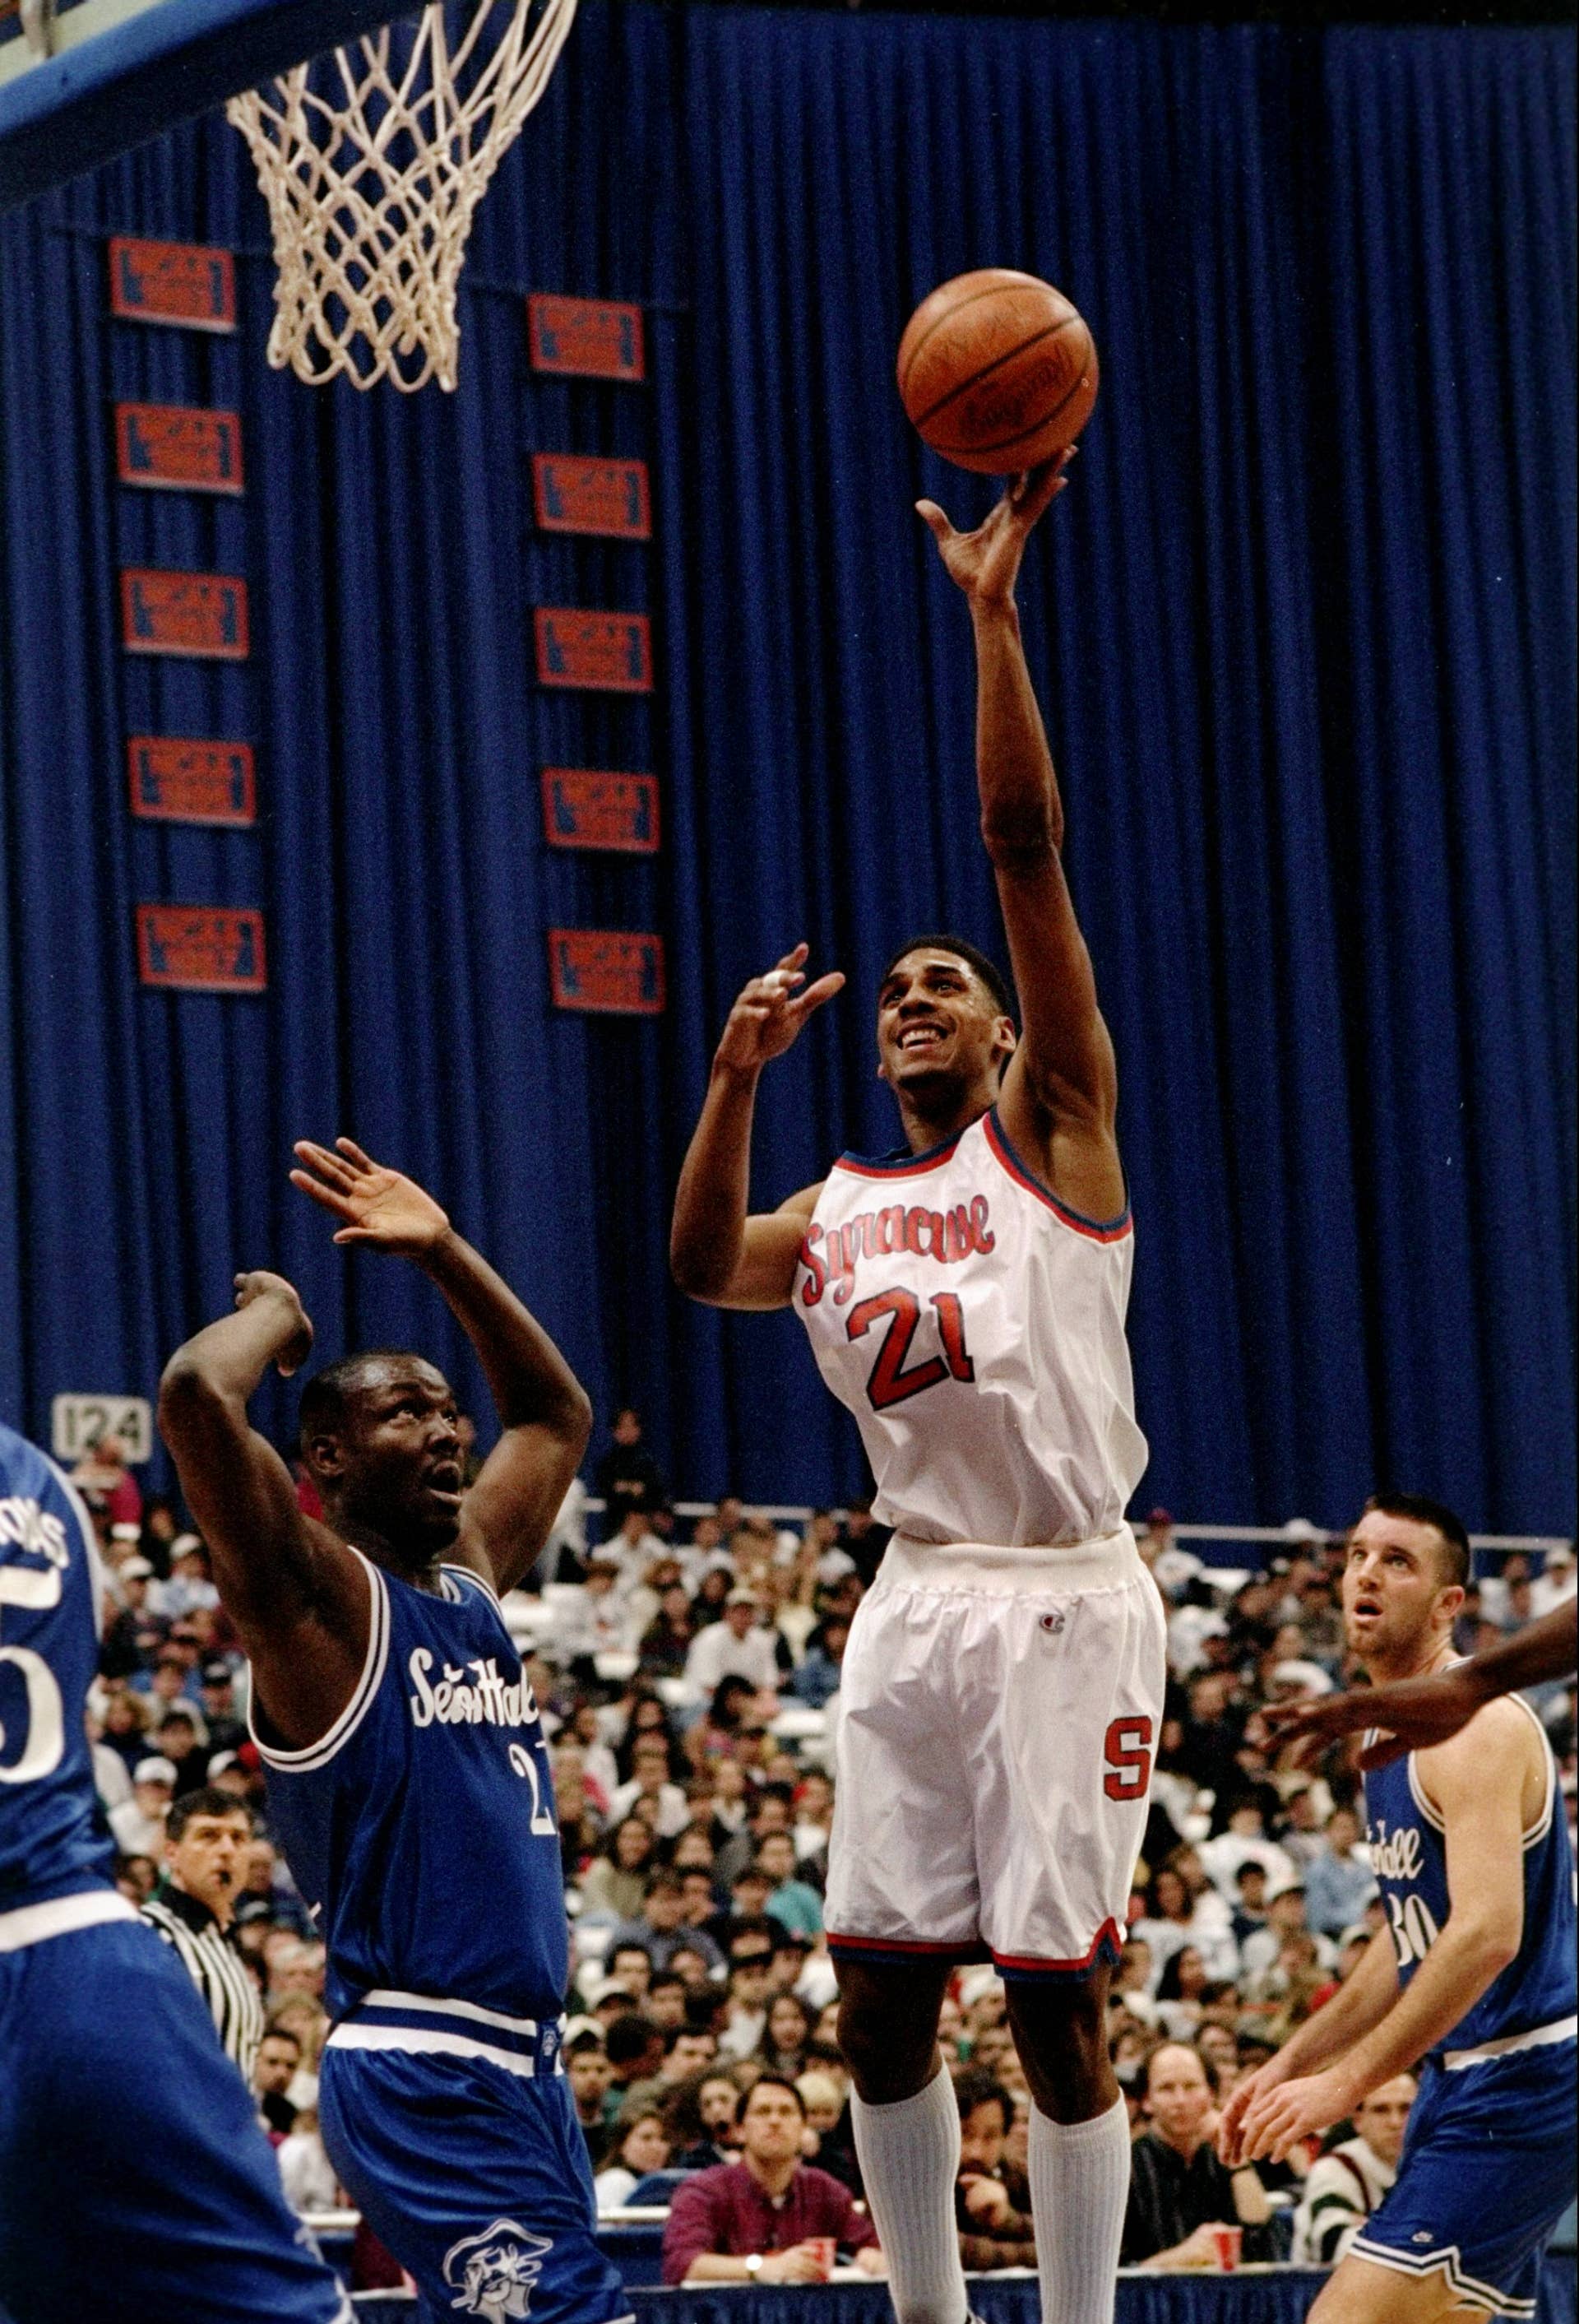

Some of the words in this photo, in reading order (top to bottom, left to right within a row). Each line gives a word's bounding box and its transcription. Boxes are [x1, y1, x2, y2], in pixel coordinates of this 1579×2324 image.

[799, 1194, 996, 1306] Syracuse
[845, 1286, 975, 1412] 21
[66, 1406, 140, 1451] 124
[0, 1495, 68, 1569] ONS
[467, 1658, 540, 1727] Hal
[508, 1740, 557, 1835] 2
[1104, 1714, 1152, 1802] S
